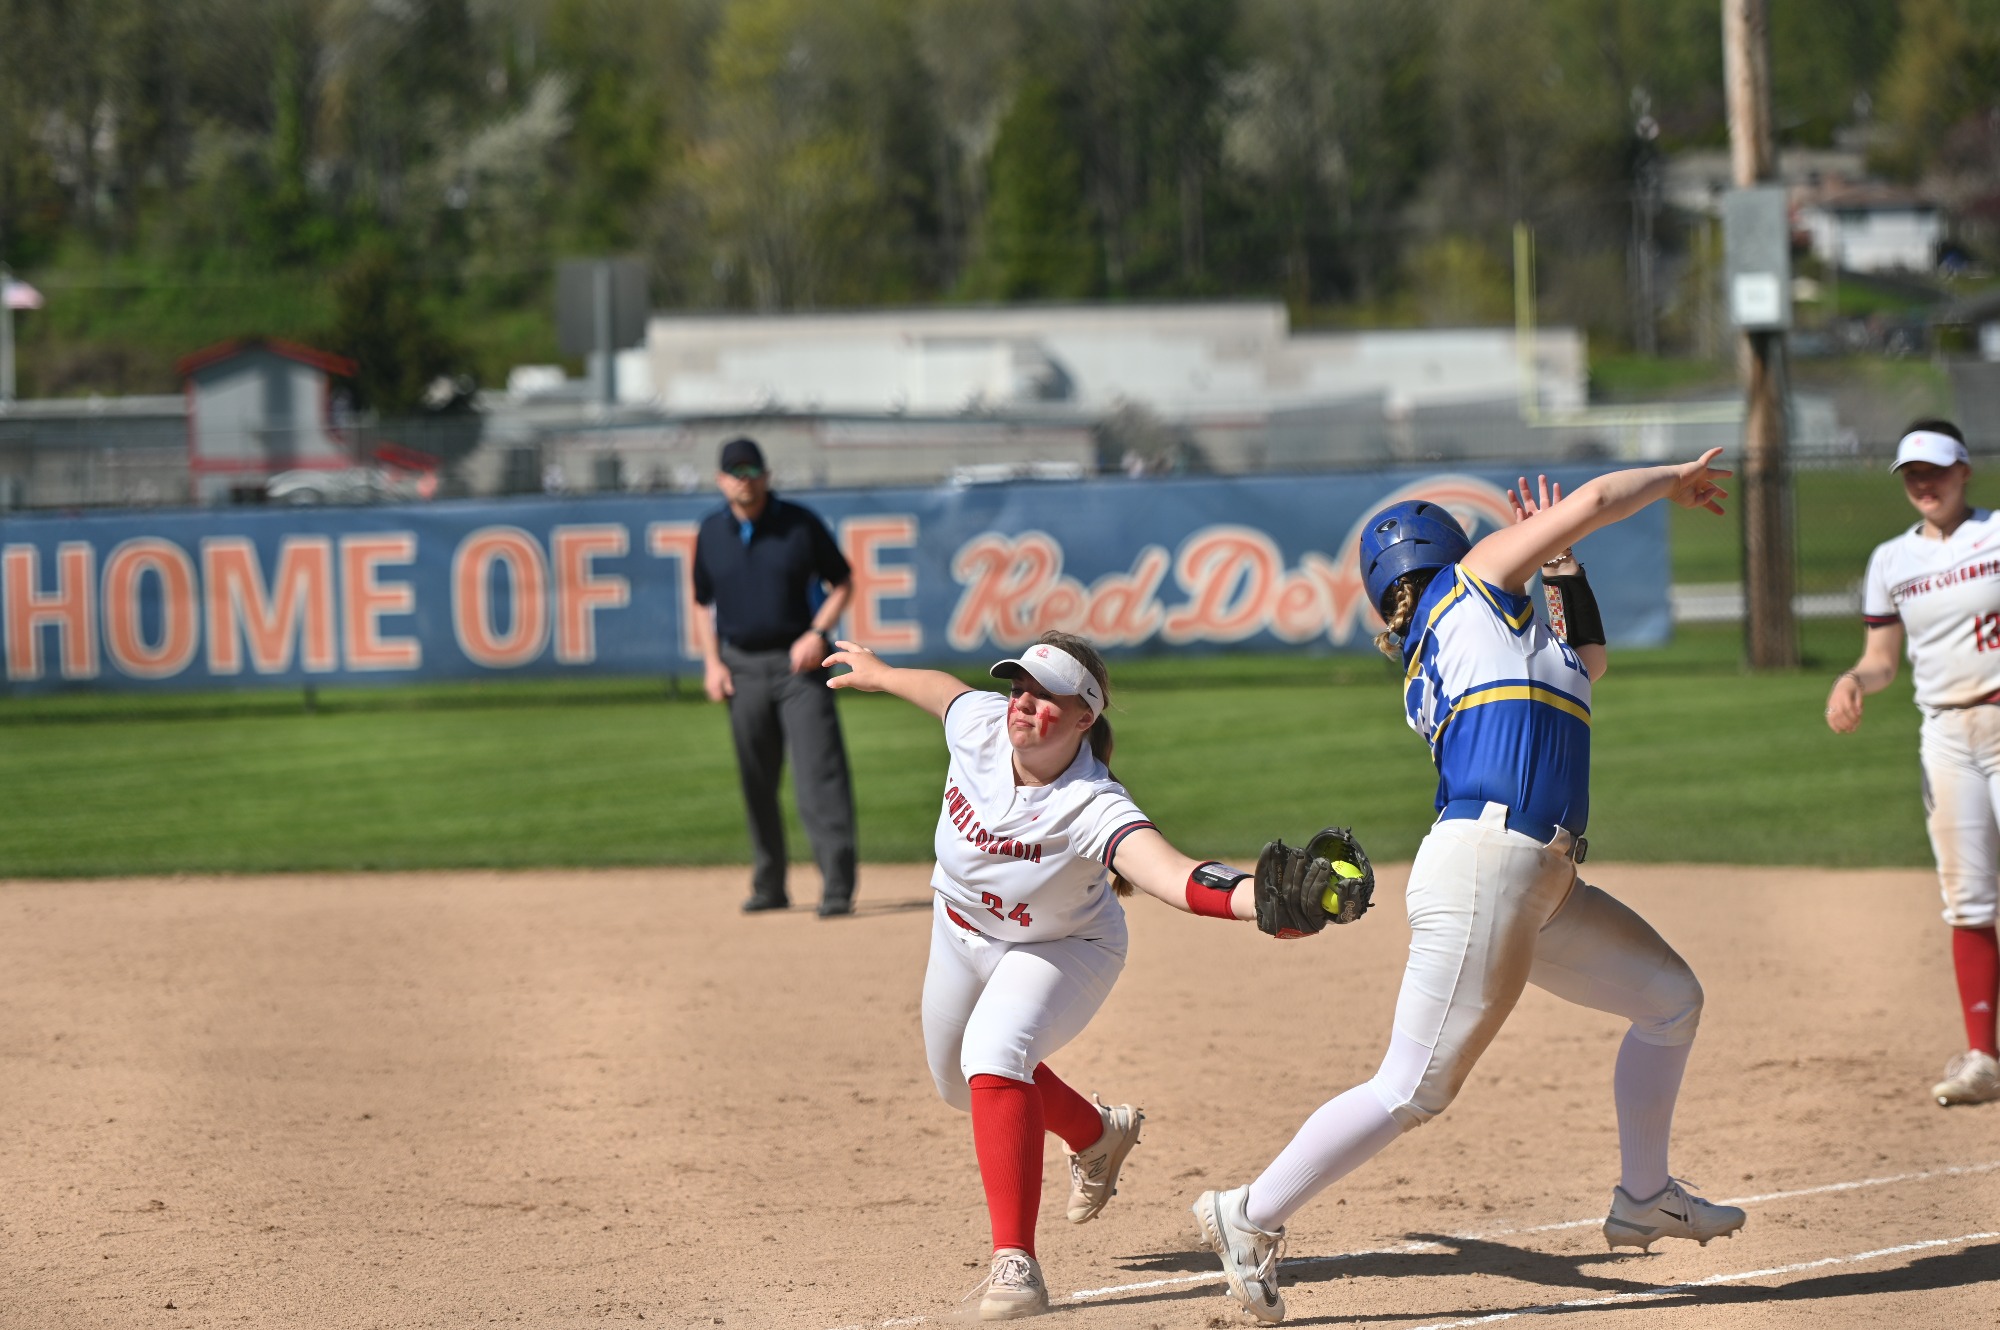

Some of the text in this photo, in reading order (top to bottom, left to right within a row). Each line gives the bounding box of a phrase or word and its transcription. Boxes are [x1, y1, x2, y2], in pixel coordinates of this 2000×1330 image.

[2, 531, 422, 681] HOME
[451, 523, 630, 668] OF
[647, 513, 924, 661] TE
[947, 529, 1167, 651] Red
[945, 777, 1042, 864] OWE COLUMBIA
[981, 890, 1033, 927] 24
